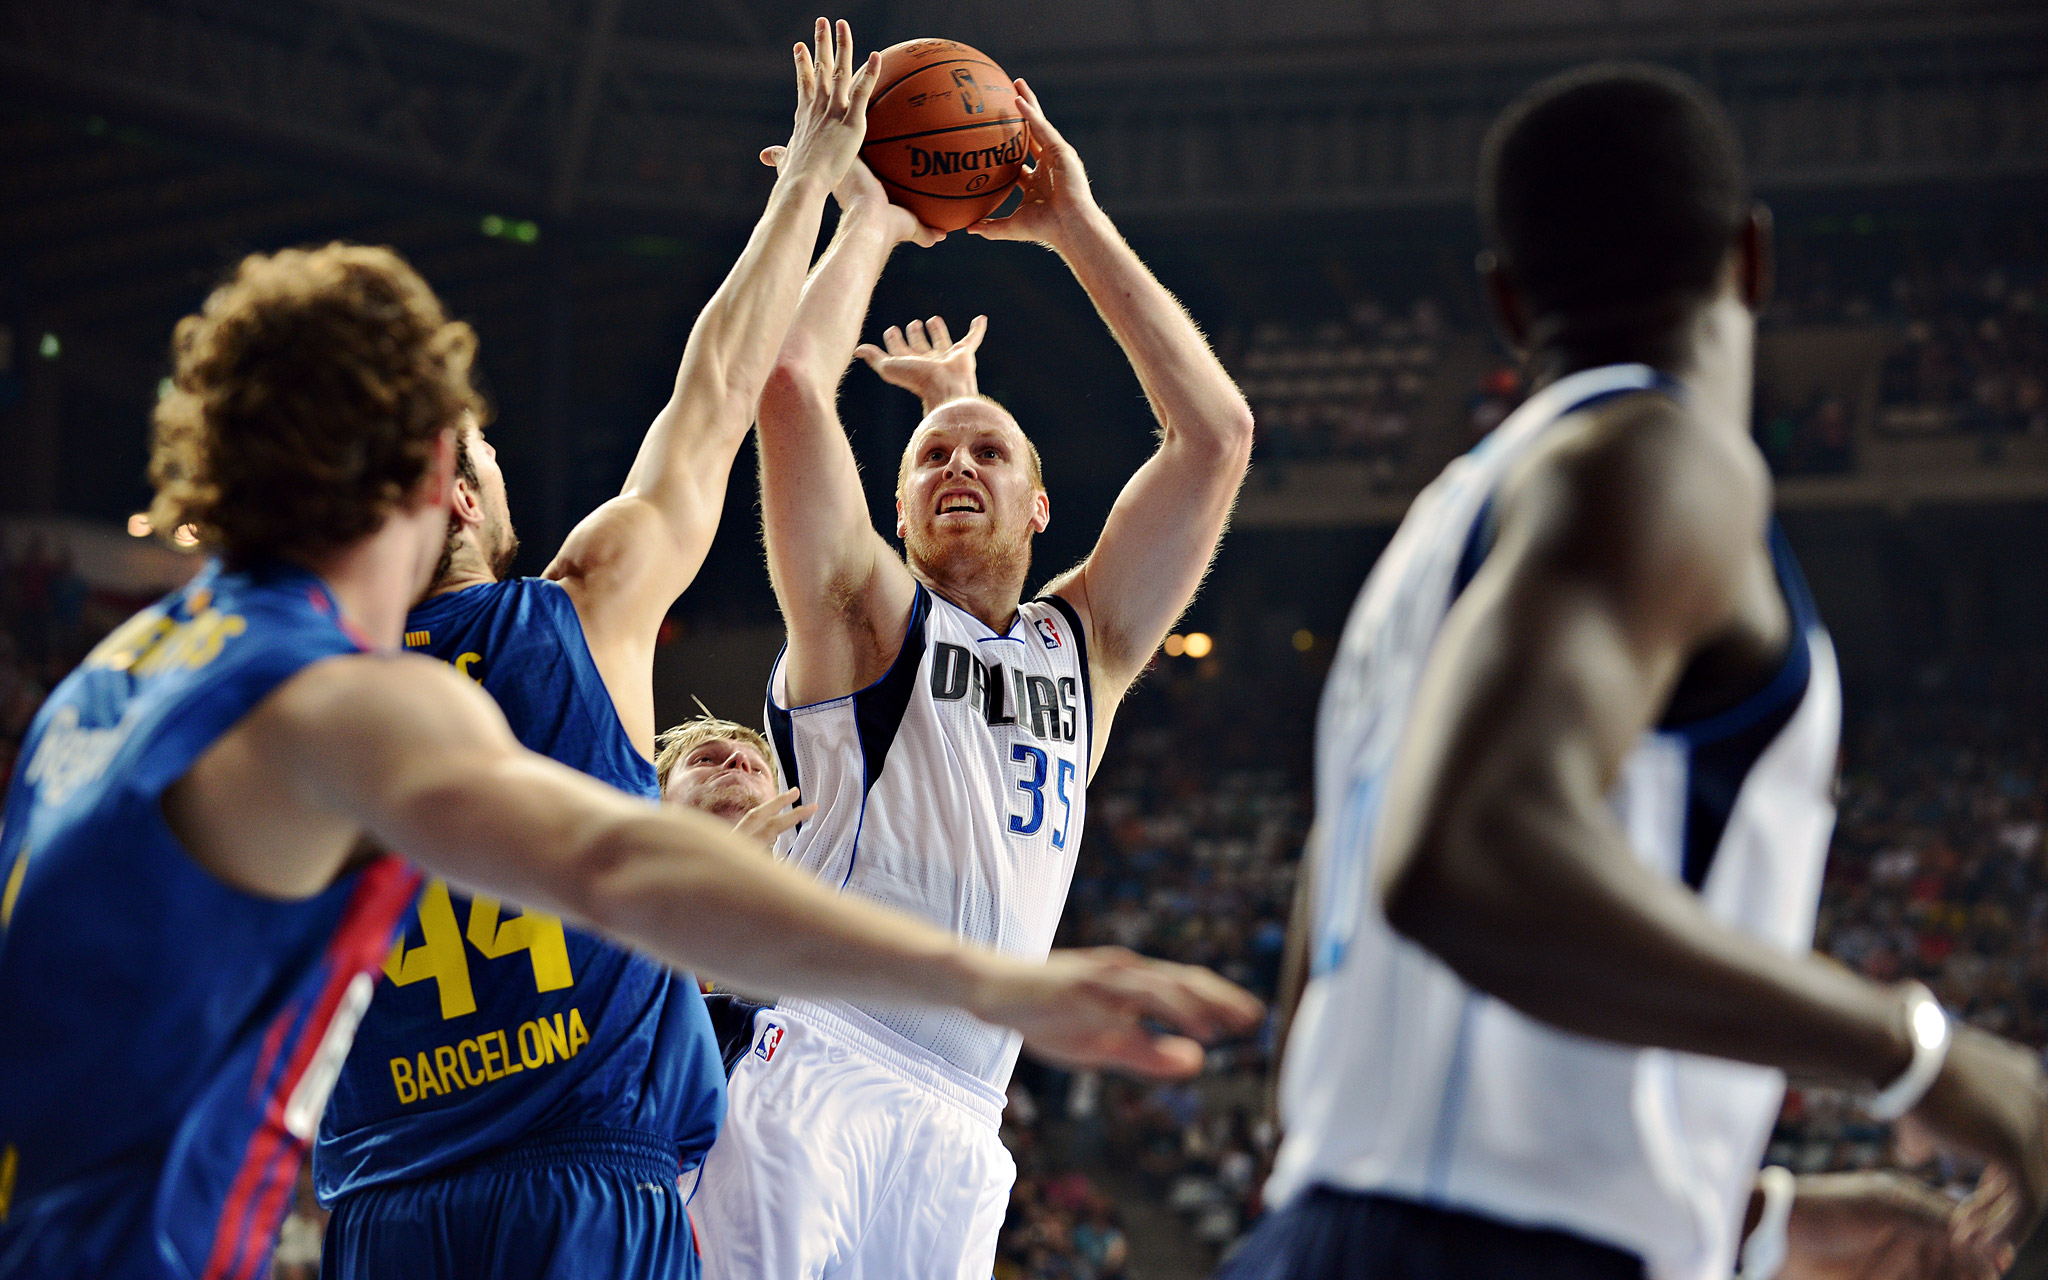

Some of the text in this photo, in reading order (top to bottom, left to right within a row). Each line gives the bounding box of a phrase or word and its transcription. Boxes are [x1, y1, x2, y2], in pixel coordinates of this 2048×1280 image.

[911, 131, 1023, 178] SPALDING
[930, 641, 1076, 744] DALLAS
[1007, 742, 1076, 852] 35
[381, 874, 575, 1021] 44
[389, 1007, 590, 1105] BARCELONA
